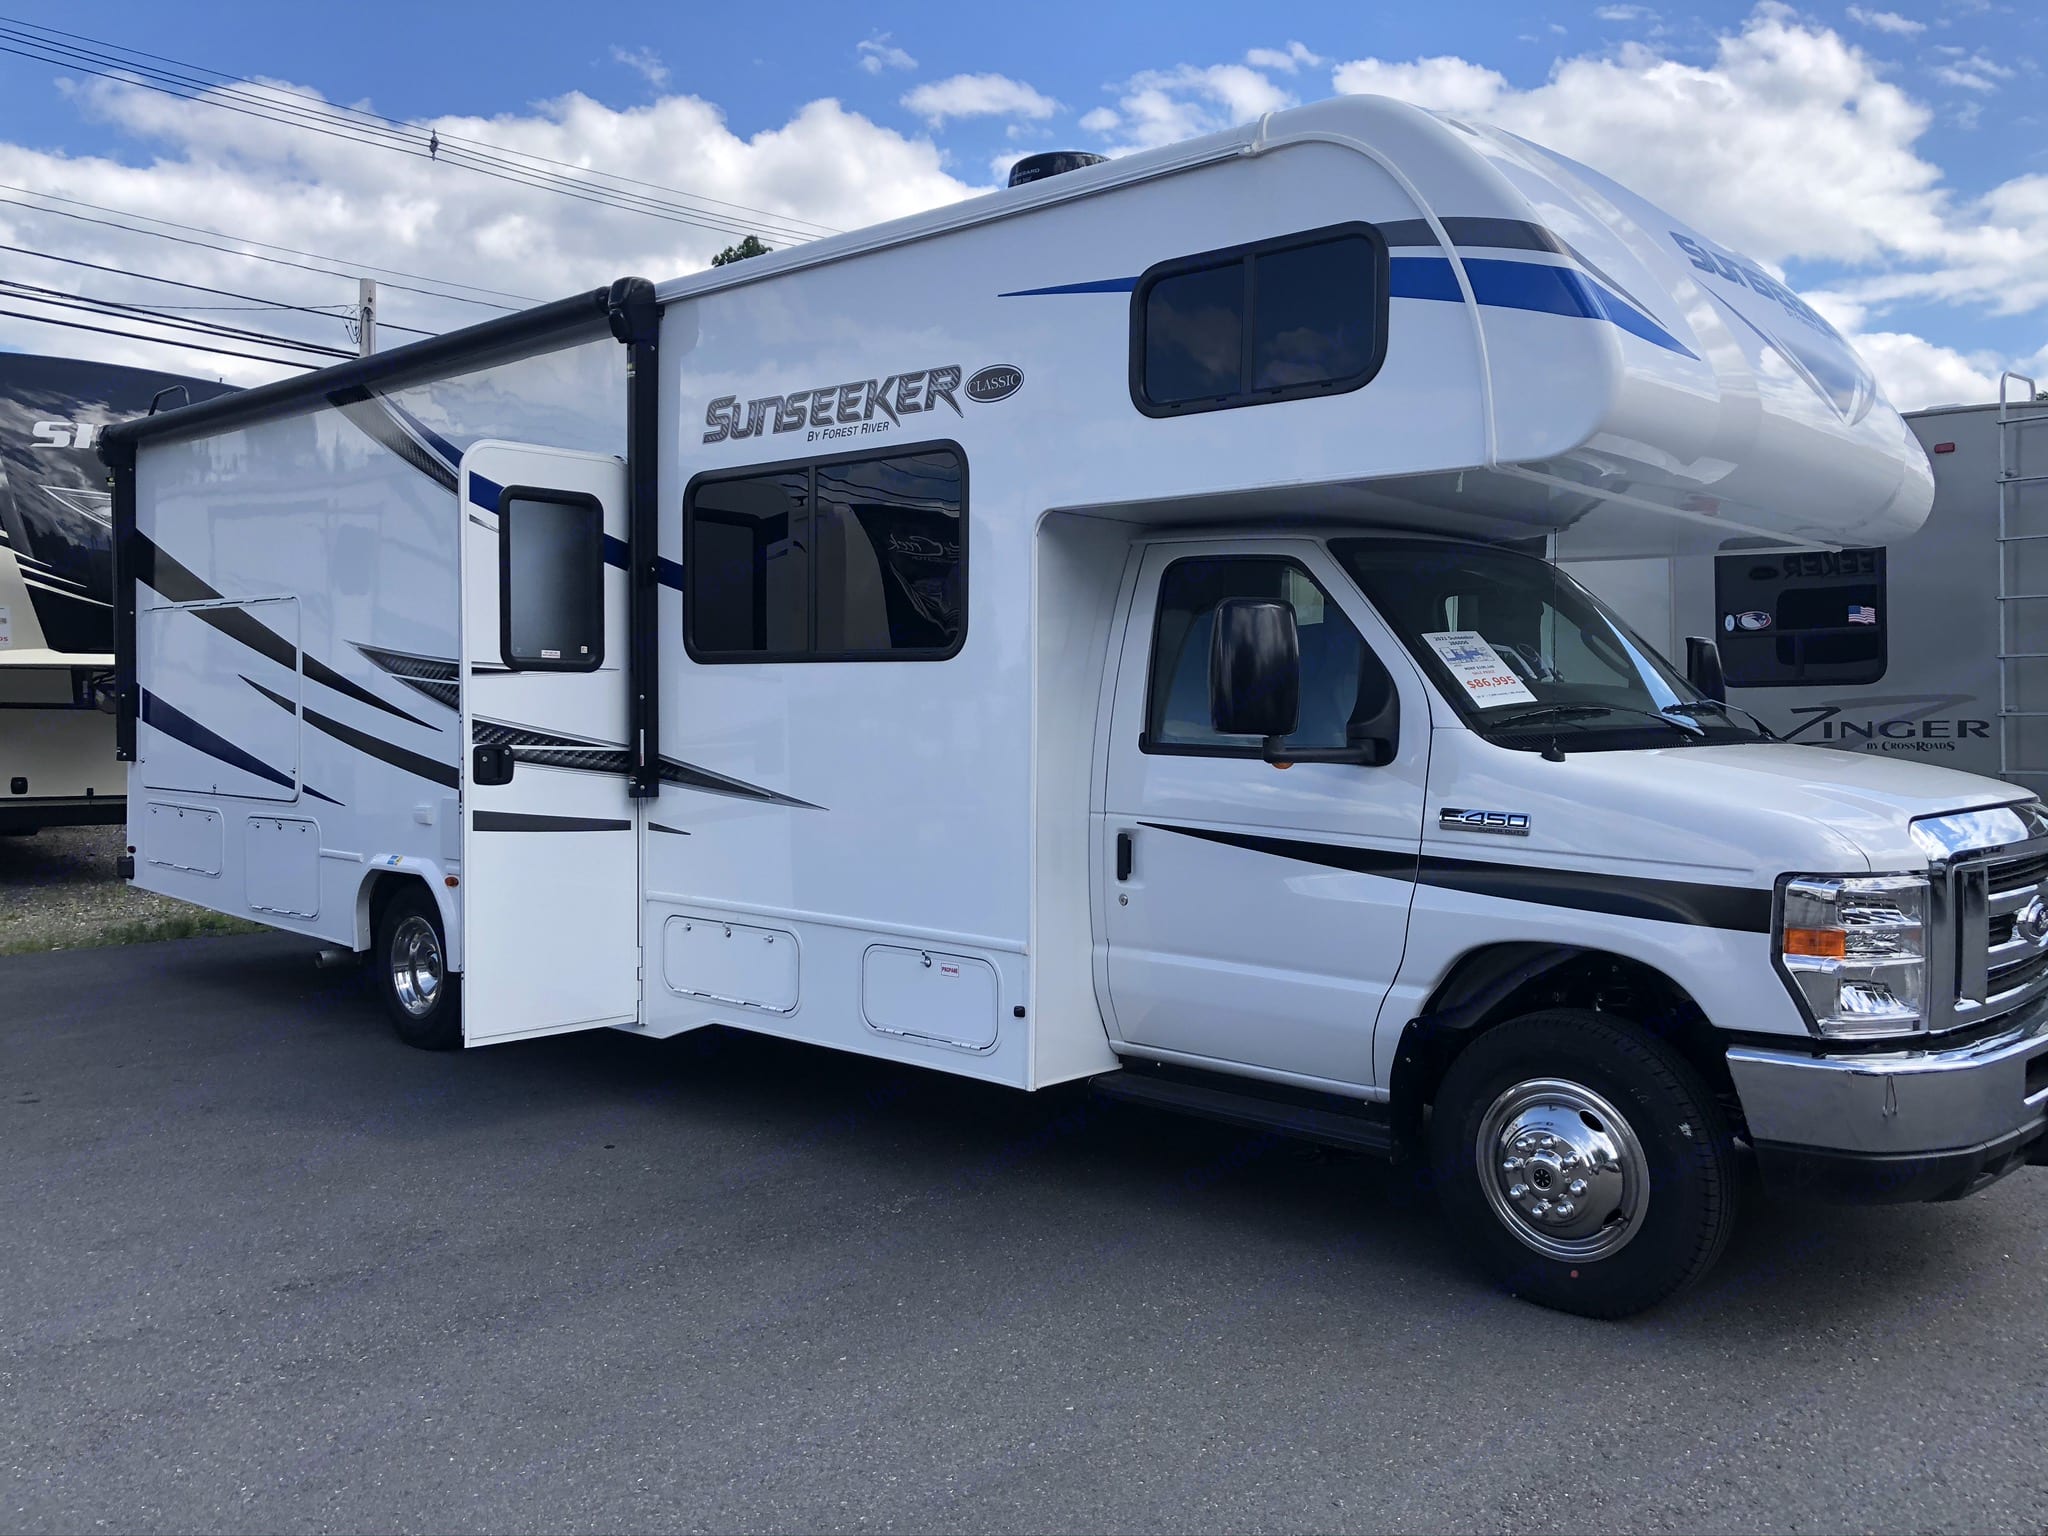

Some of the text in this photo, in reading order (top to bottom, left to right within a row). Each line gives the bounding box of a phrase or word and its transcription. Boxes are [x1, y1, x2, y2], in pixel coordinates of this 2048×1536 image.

[702, 364, 1019, 445] SUNSEEKER CLASSIC
[822, 425, 859, 440] FOREST
[861, 421, 890, 434] RIVER
[1466, 675, 1517, 690] $86,995
[1781, 706, 1990, 745] ZINGER
[1440, 808, 1529, 827] E-450
